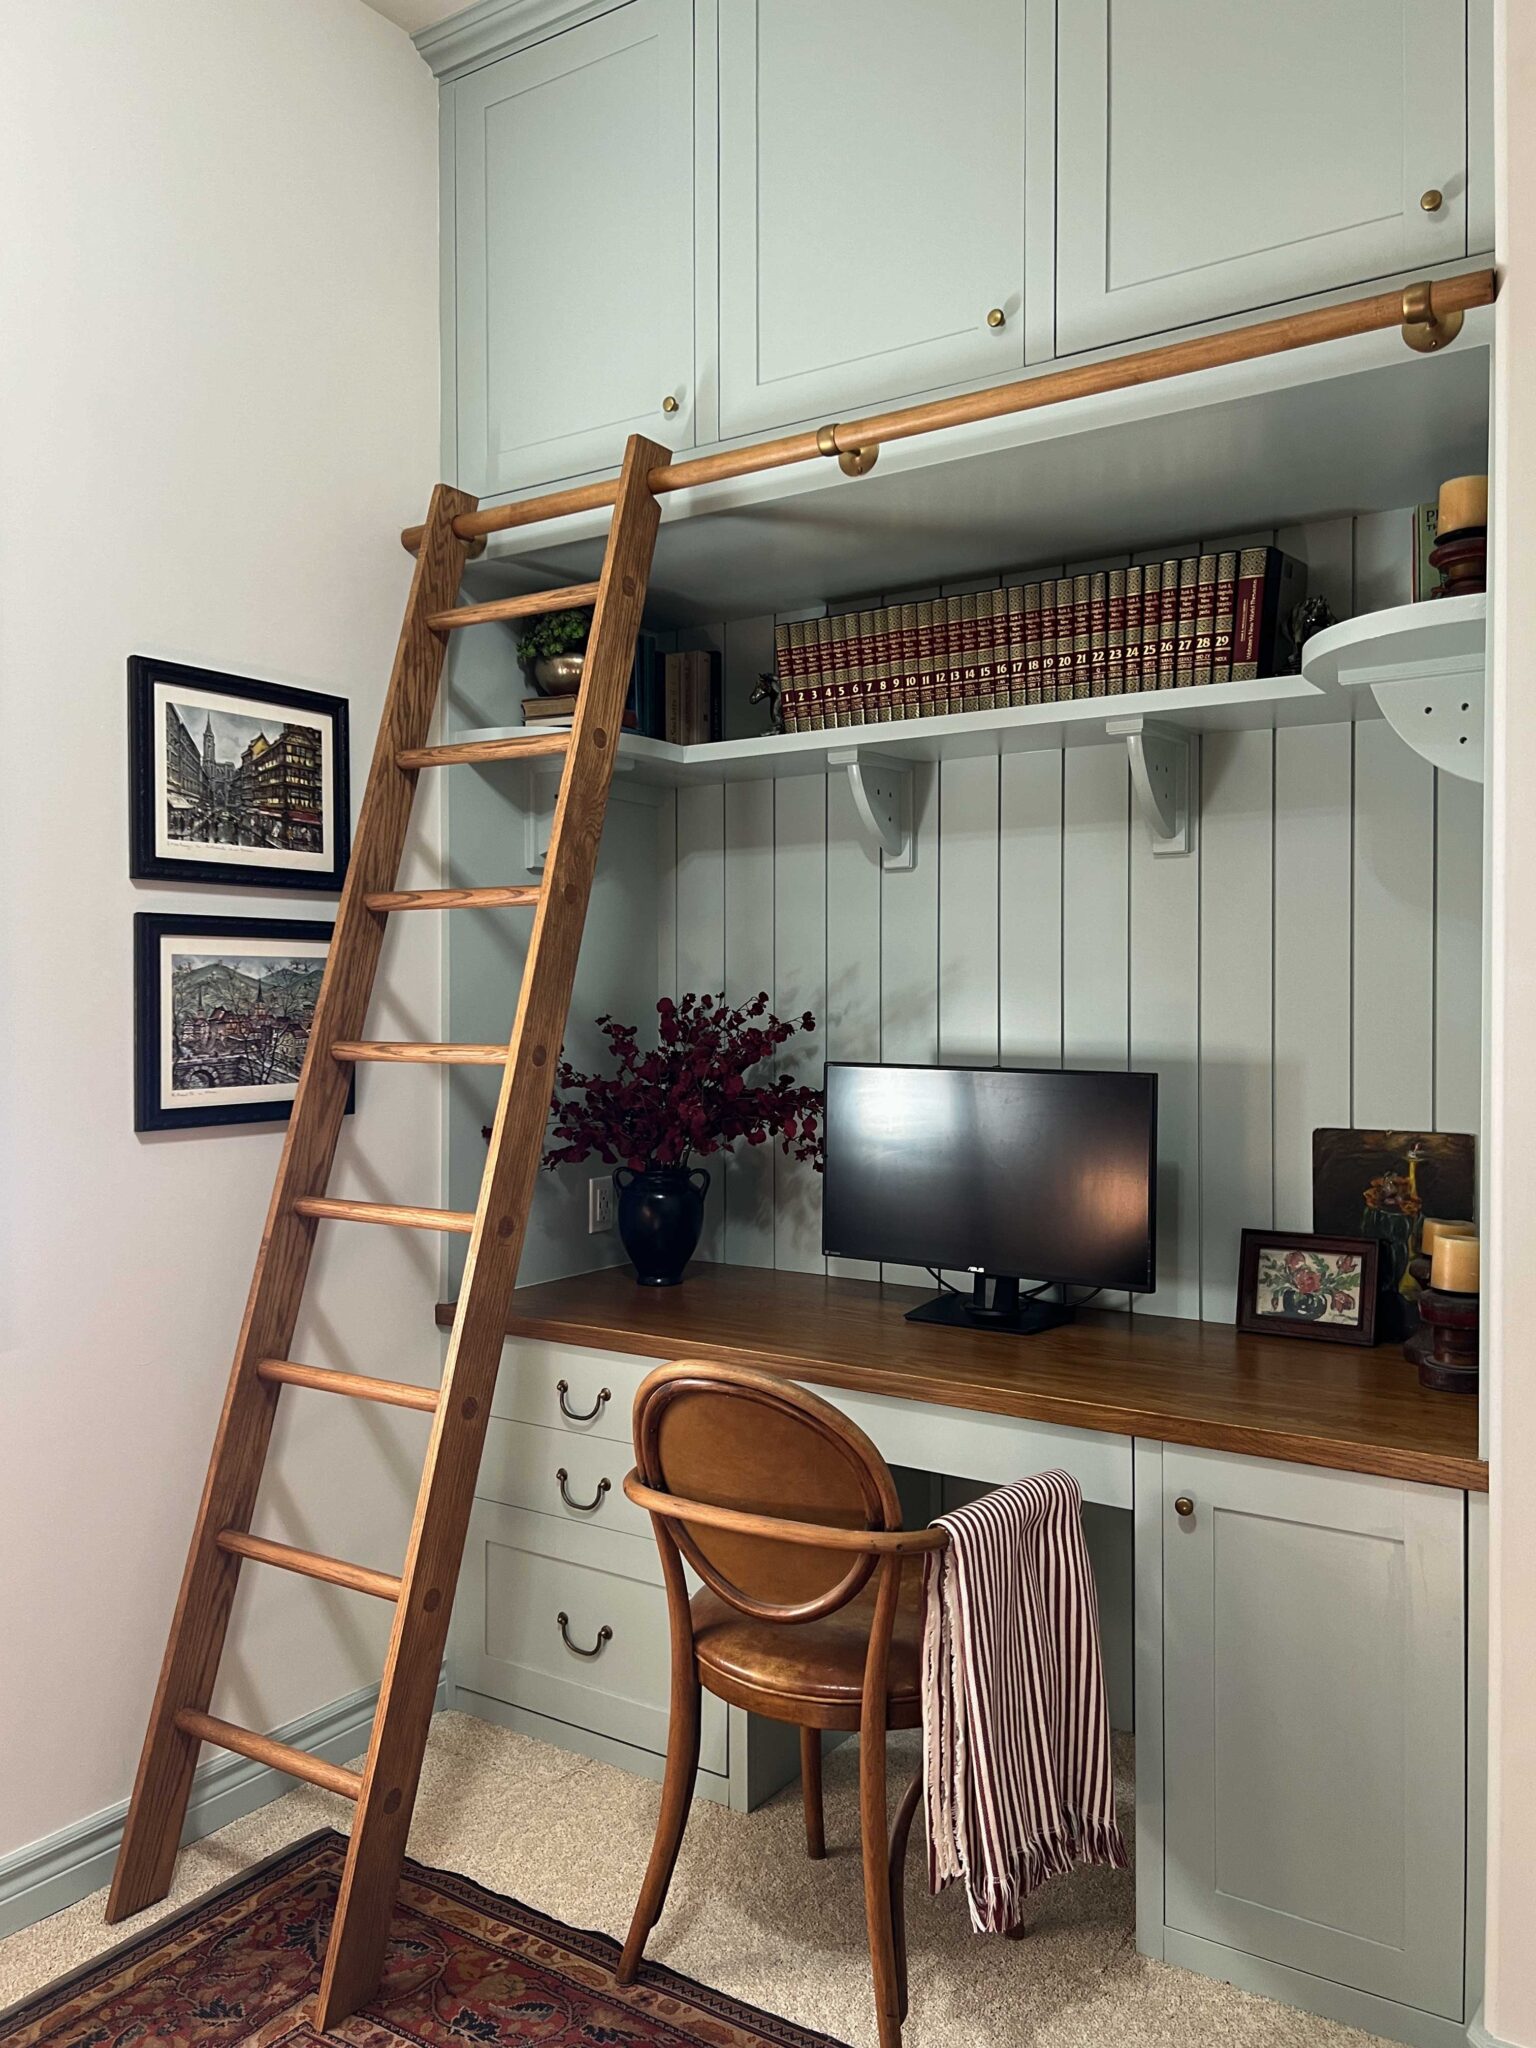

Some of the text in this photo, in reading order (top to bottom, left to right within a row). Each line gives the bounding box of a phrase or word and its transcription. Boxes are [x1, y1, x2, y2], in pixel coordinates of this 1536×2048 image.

[1178, 640, 1192, 651] 27
[1196, 637, 1211, 648] 28
[1215, 636, 1229, 647] 29
[1143, 644, 1156, 656] 25
[1160, 642, 1173, 652] 26
[1092, 652, 1105, 662] 22
[1109, 649, 1122, 660] 23
[1126, 647, 1139, 658] 24
[1043, 658, 1054, 668] 19
[1058, 657, 1072, 667] 20
[1076, 654, 1087, 664] 21
[996, 664, 1008, 674] 16
[1012, 662, 1023, 673] 17
[1028, 660, 1039, 670] 18
[950, 671, 960, 681] 13
[965, 669, 975, 679] 14
[980, 666, 991, 677] 15
[906, 676, 917, 687] 10
[922, 675, 930, 685] 11
[936, 672, 946, 683] 12
[866, 682, 873, 692] 7
[880, 681, 887, 690] 8
[893, 678, 900, 688] 9
[825, 688, 832, 697] 4
[838, 687, 845, 696] 5
[852, 684, 859, 693] 6
[785, 694, 789, 702] 1
[798, 692, 805, 701] 2
[812, 690, 818, 699] 3
